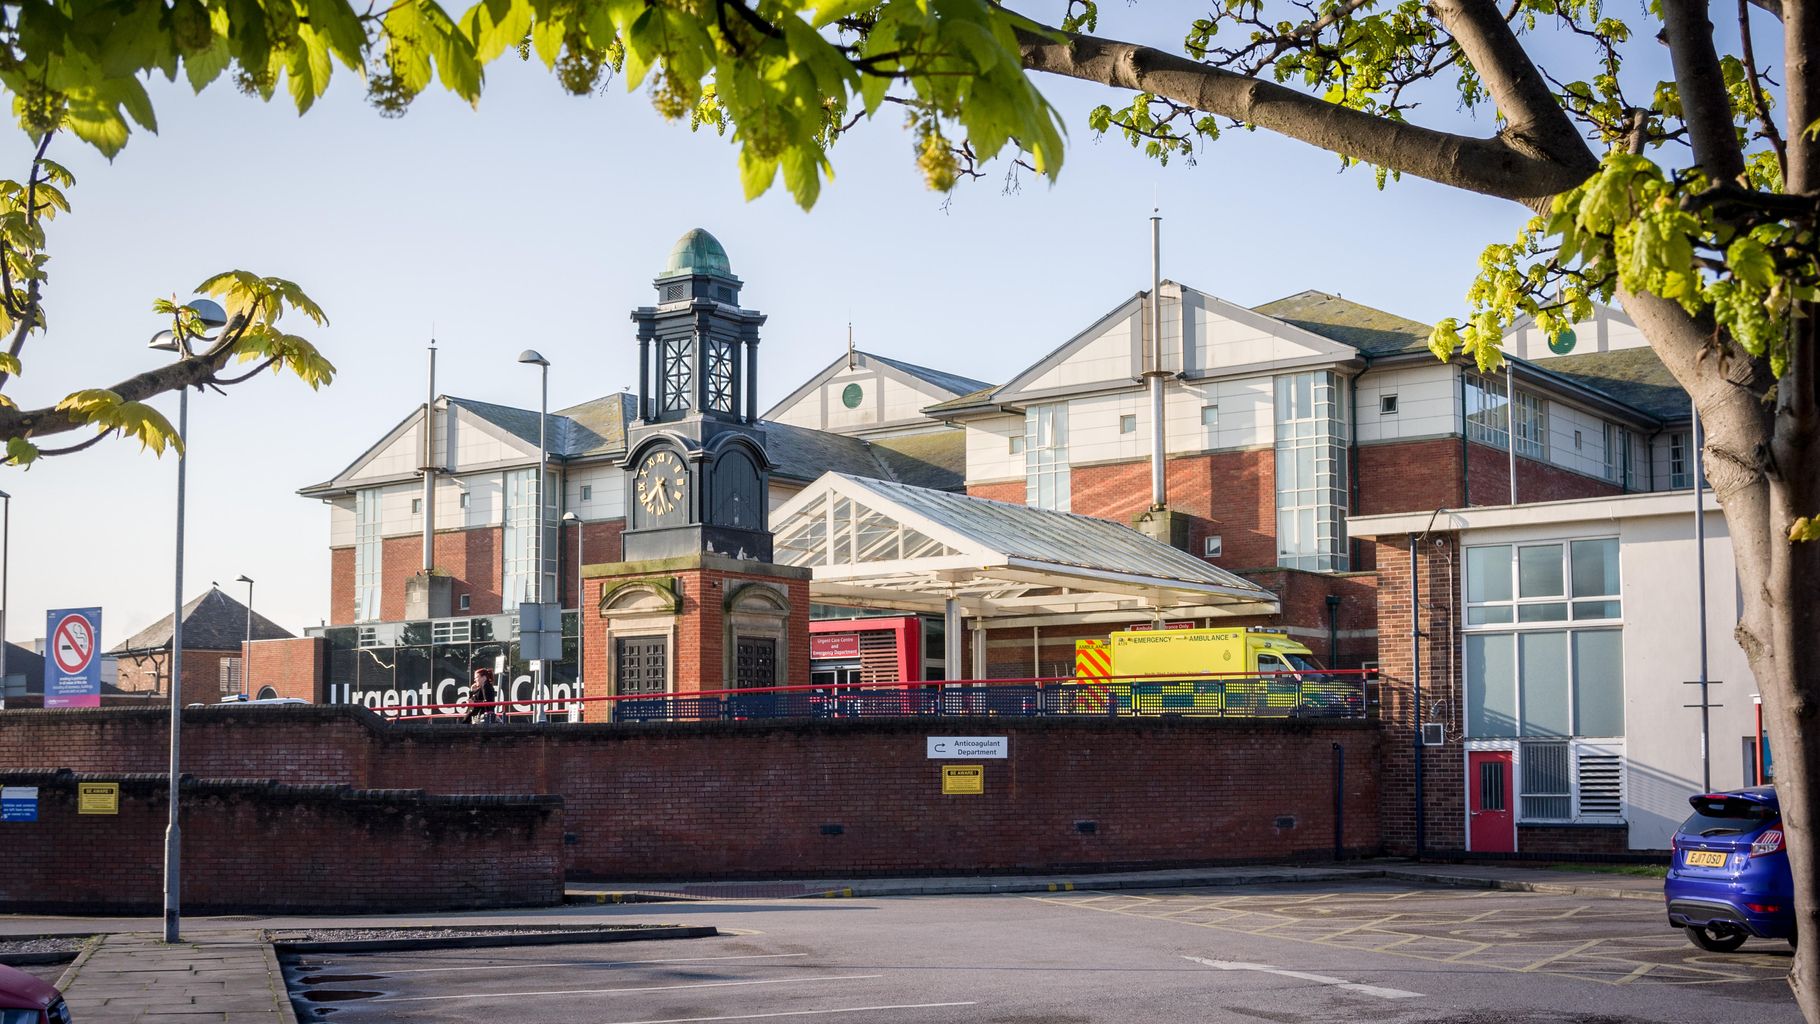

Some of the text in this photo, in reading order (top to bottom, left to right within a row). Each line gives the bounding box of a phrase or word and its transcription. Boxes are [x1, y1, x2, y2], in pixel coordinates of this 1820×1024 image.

[331, 682, 432, 717] Urgent
[510, 675, 585, 713] Cent
[954, 740, 1000, 748] Anticoagulant
